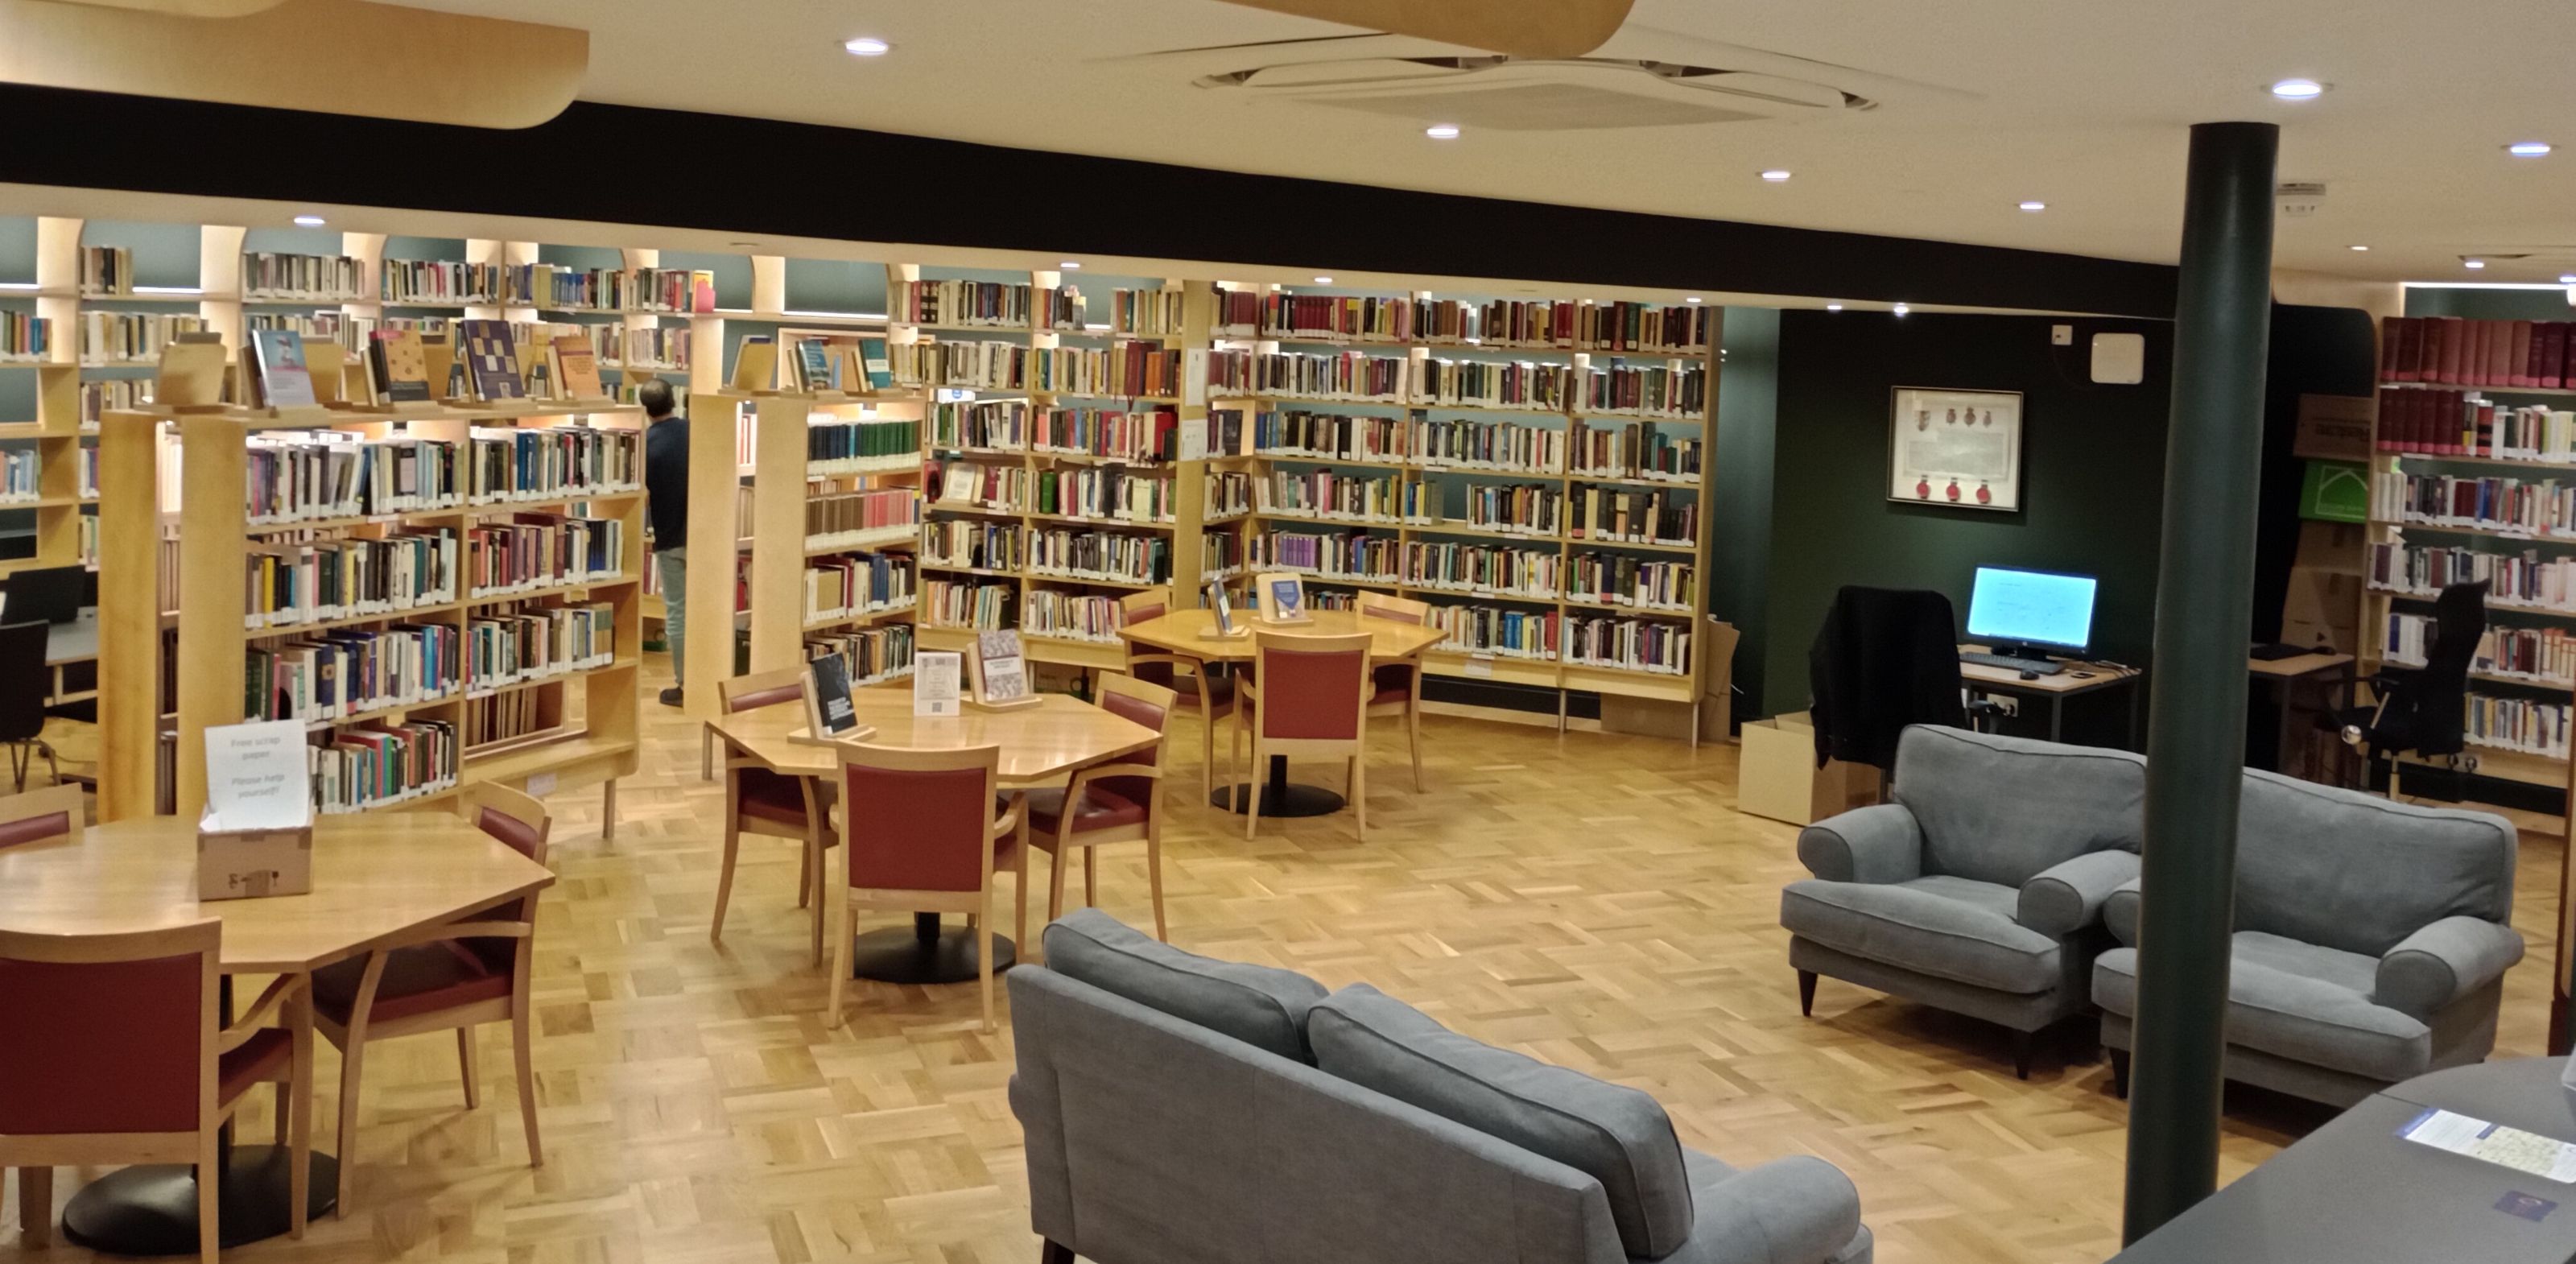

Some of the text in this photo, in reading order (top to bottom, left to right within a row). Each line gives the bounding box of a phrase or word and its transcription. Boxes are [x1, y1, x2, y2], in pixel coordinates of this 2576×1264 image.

[231, 737, 281, 747] Free scrap
[242, 750, 270, 761] paper
[231, 774, 285, 786] Please help
